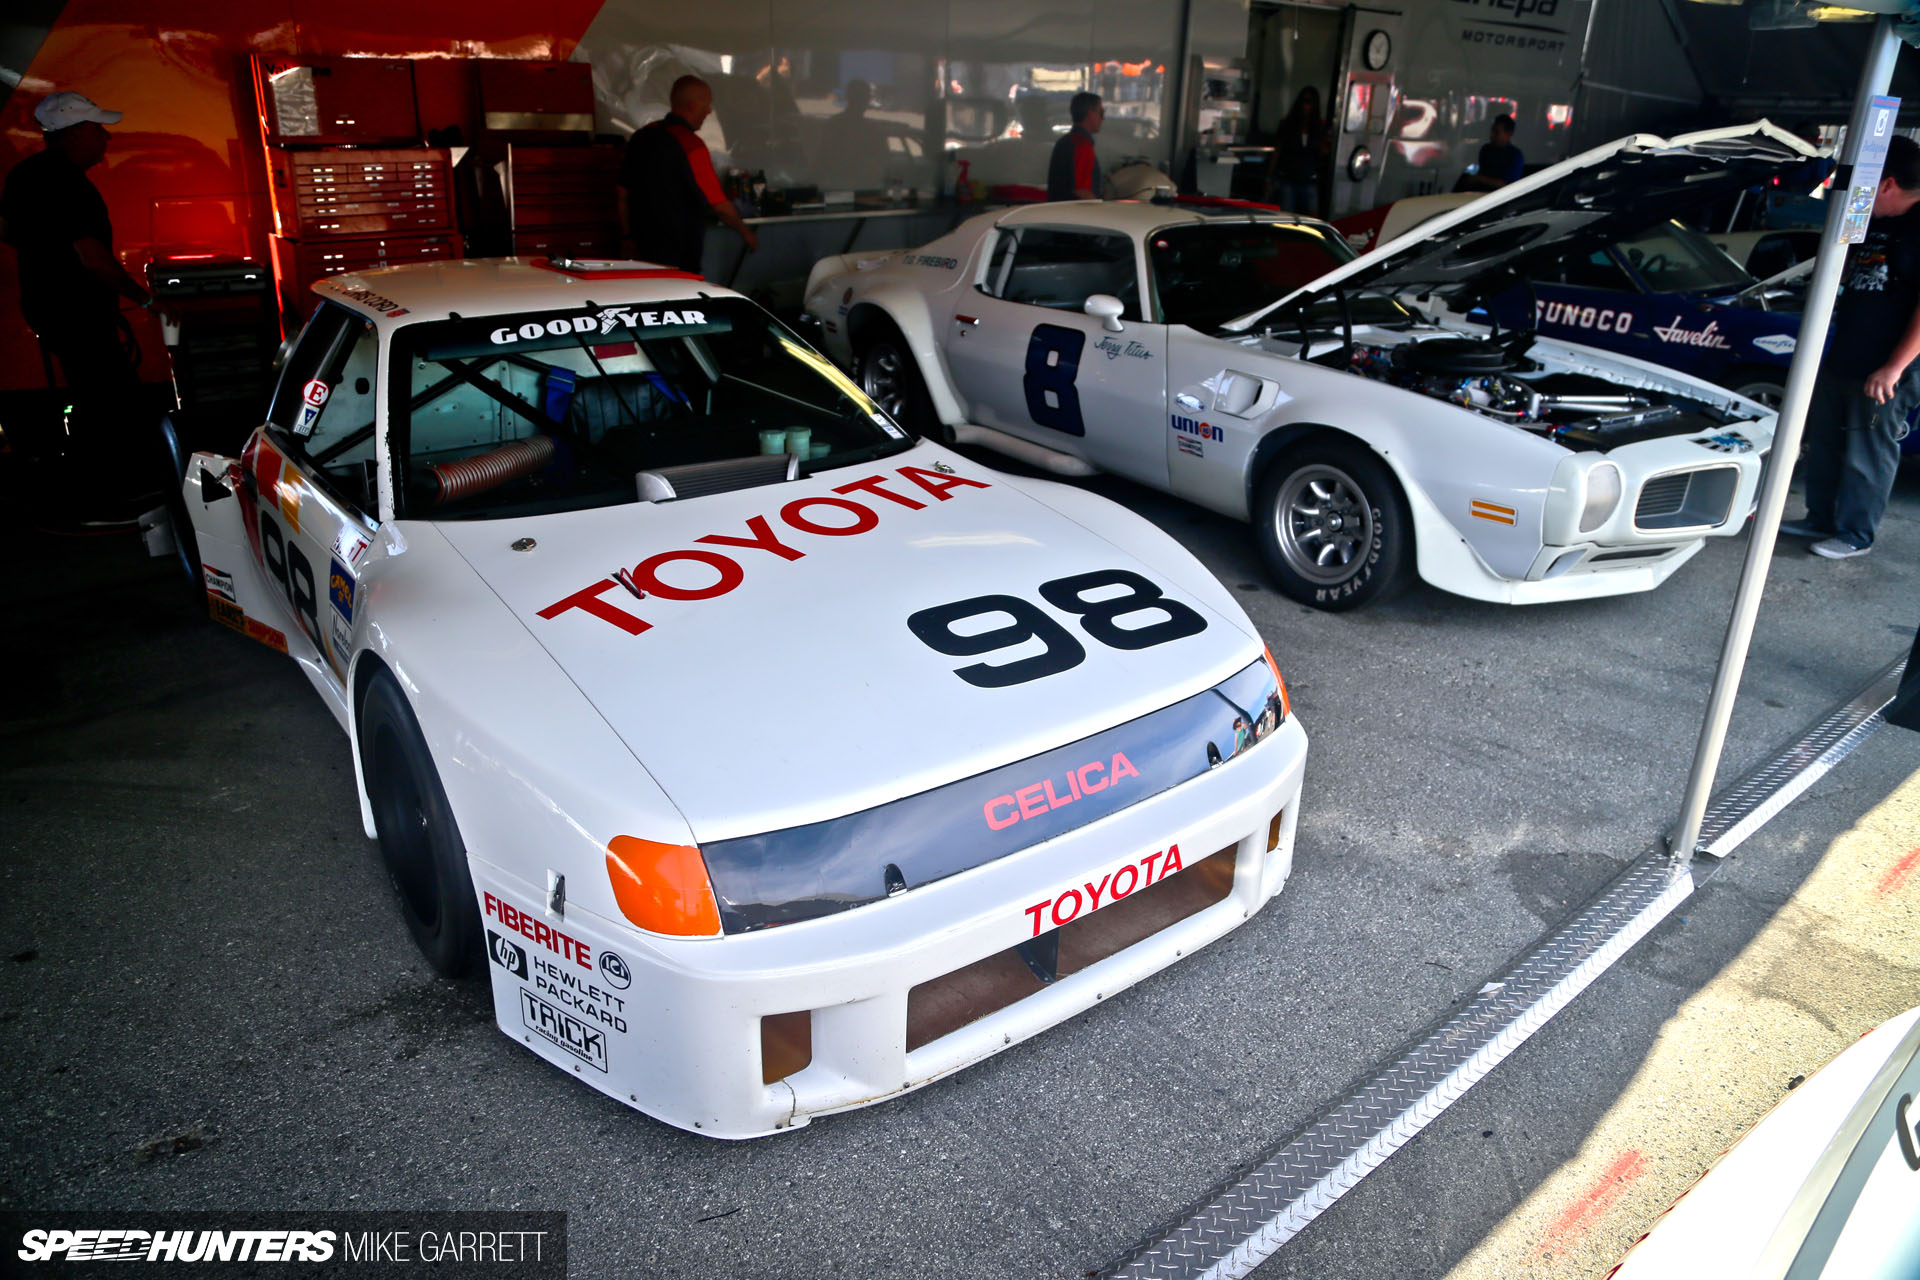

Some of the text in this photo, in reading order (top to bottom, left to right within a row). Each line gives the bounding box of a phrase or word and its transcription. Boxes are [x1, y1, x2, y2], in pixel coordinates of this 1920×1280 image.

[1462, 29, 1565, 52] MOTORSPORT
[1124, 340, 1154, 360] Titus
[1653, 315, 1731, 349] Javelin
[309, 383, 327, 404] E
[1024, 322, 1086, 436] 8
[537, 466, 991, 637] TOYOTA
[205, 573, 233, 592] CHAMPION
[331, 574, 353, 609] CAMEL
[907, 569, 1208, 689] 98
[984, 752, 1140, 831] CELICA
[1025, 844, 1184, 936] TOYOTA
[483, 891, 593, 971] FIBERITE
[534, 956, 626, 1013] HEWLETT
[536, 975, 628, 1034] PACKARD
[524, 993, 602, 1059] TRICK
[535, 1024, 593, 1062] racing gasoline
